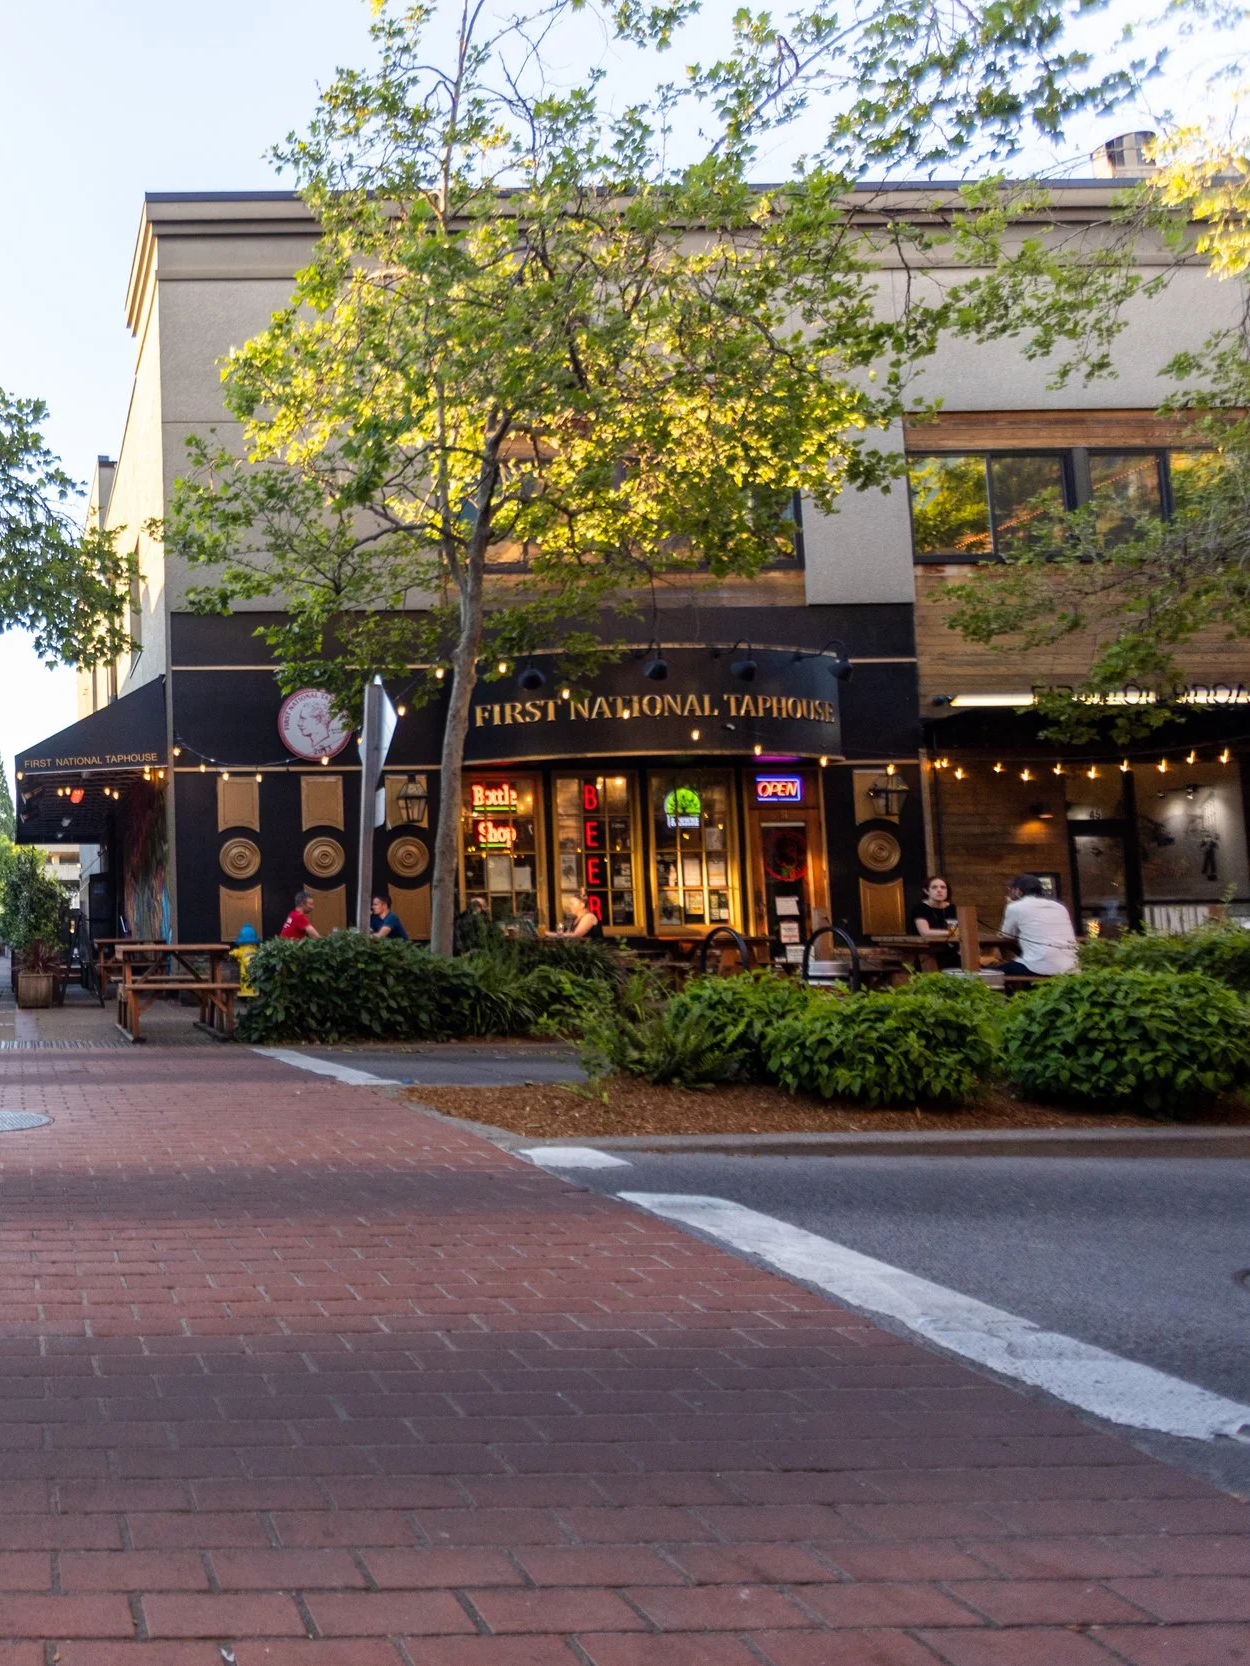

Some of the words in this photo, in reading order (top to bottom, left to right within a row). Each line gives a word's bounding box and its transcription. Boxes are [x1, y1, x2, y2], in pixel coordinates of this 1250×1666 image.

[473, 699, 562, 728] FIRST
[569, 694, 719, 721] NATIONAL
[723, 694, 836, 723] TAPHOUSE
[24, 758, 52, 769] FIRST
[55, 756, 103, 767] NATIONAL
[105, 752, 158, 764] TAPHOUSE
[471, 783, 518, 806] Bottle
[756, 781, 798, 797] OPEN
[477, 821, 517, 848] Shop
[583, 784, 603, 921] BEER
